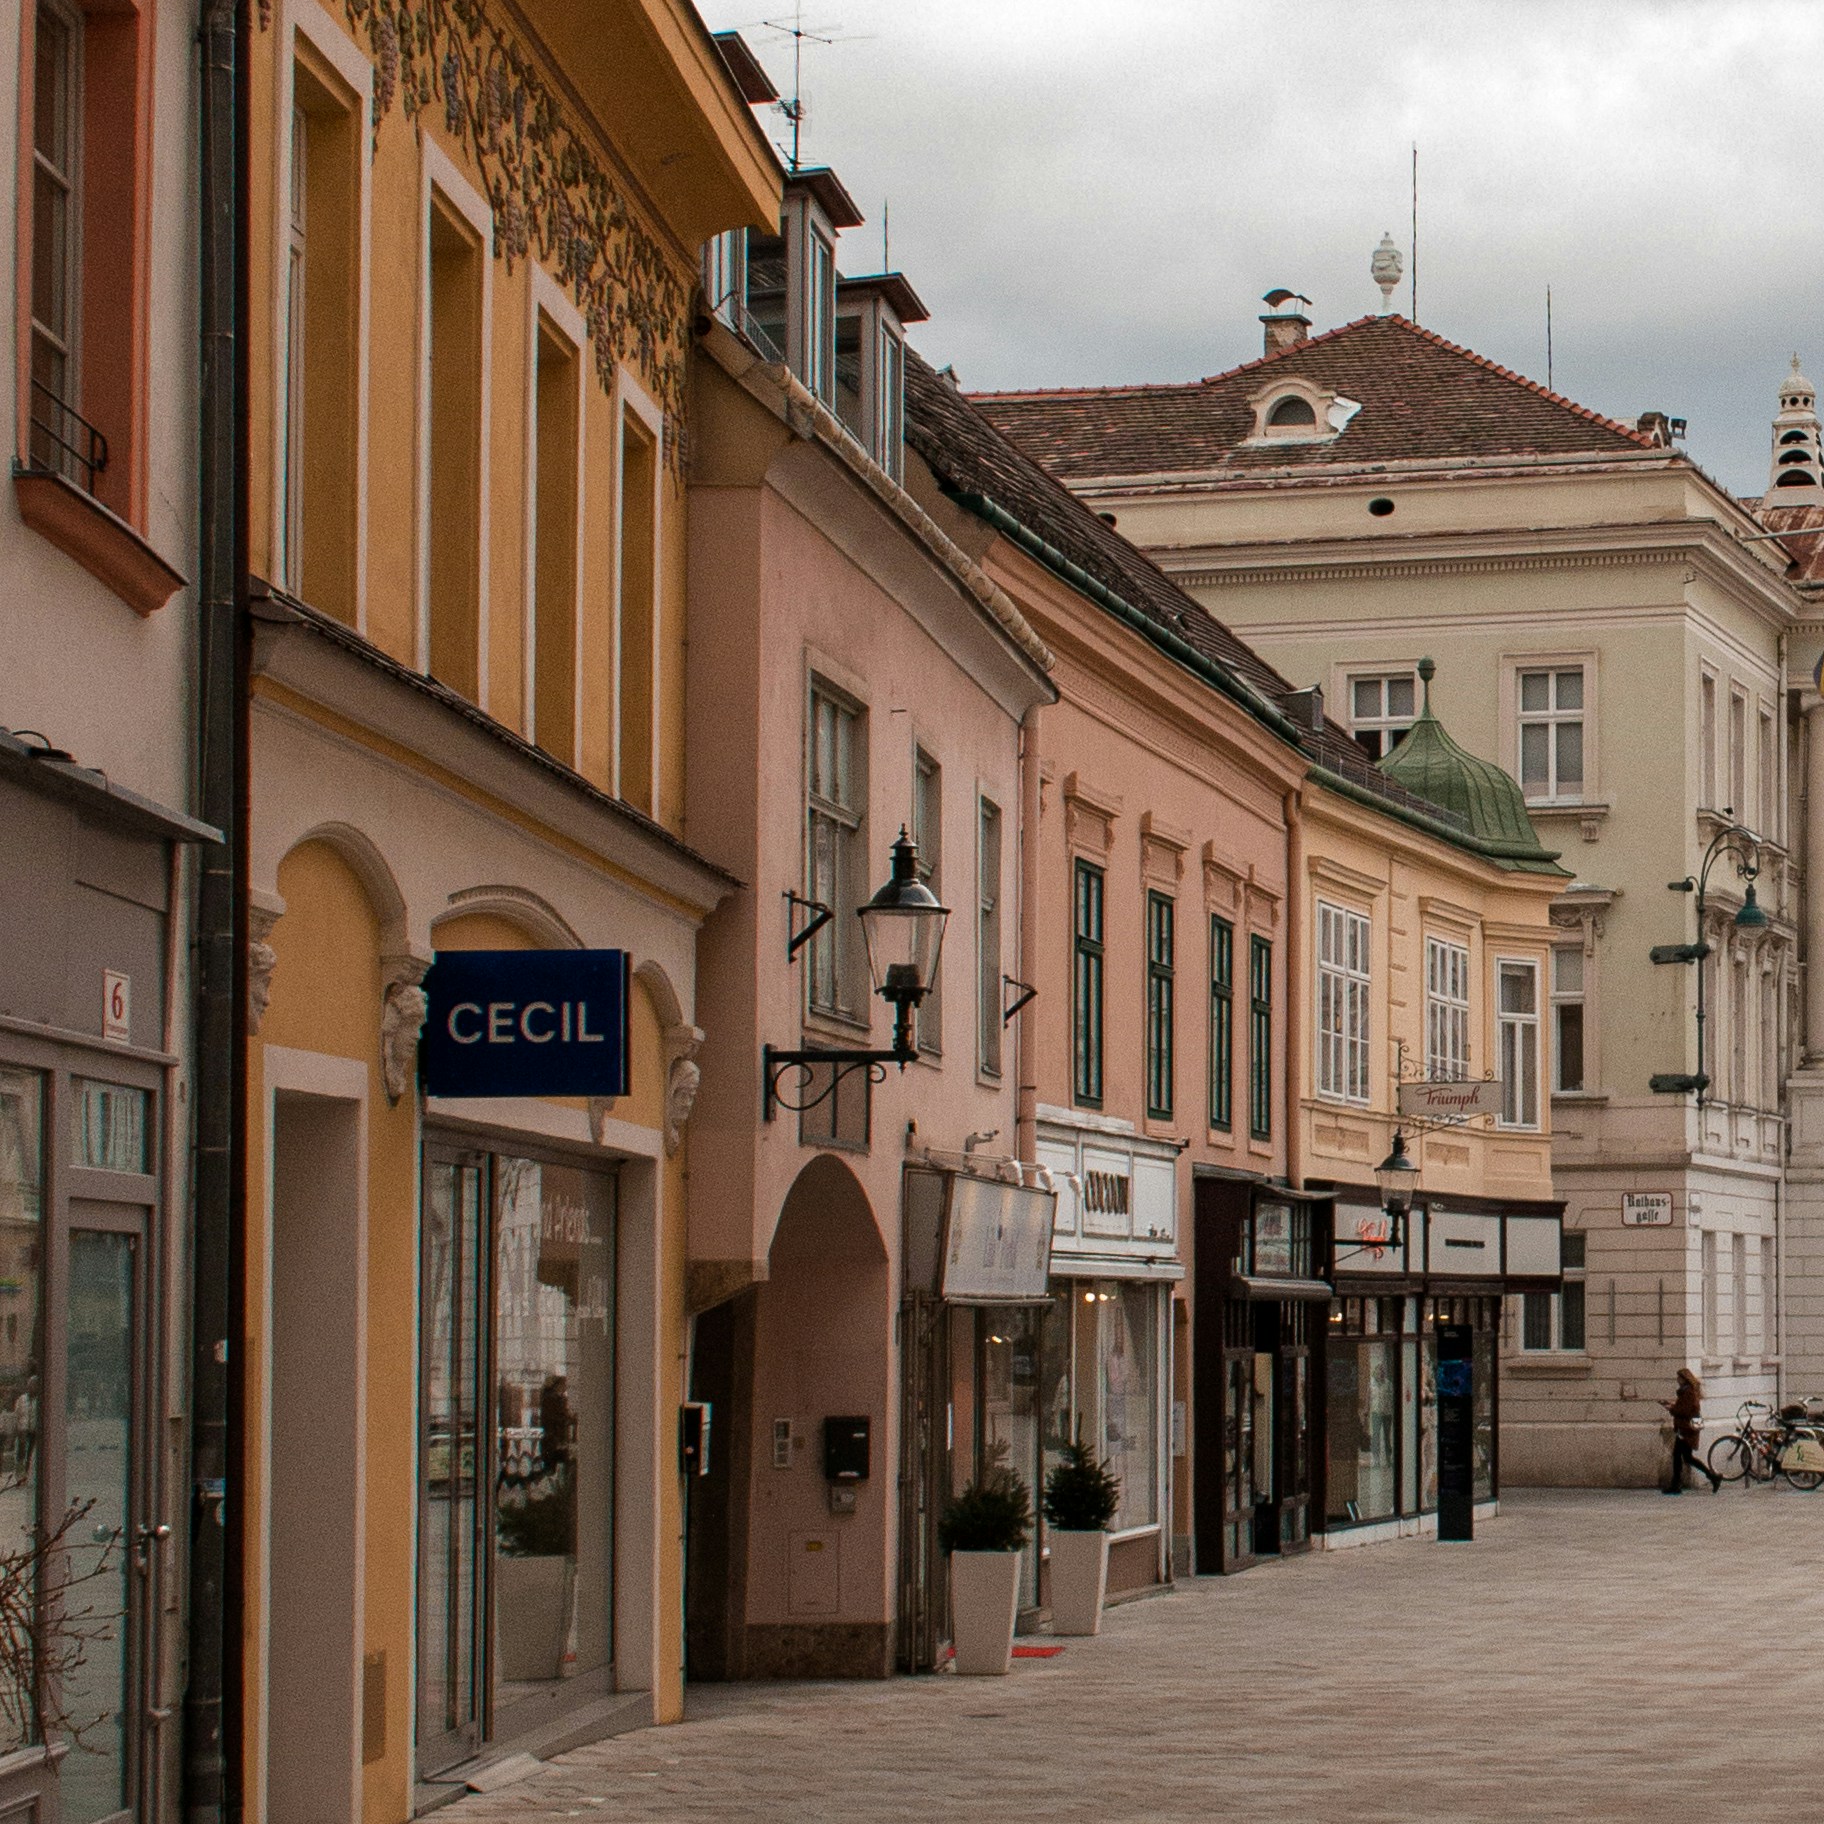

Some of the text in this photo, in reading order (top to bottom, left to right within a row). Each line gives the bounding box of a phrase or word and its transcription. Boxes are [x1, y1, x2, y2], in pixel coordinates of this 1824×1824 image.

[112, 981, 123, 1020] 6
[447, 1001, 605, 1044] CECIL
[1414, 1085, 1481, 1112] Triumph
[1626, 1193, 1670, 1208] Rathaus-
[1636, 1208, 1659, 1224] gasse
